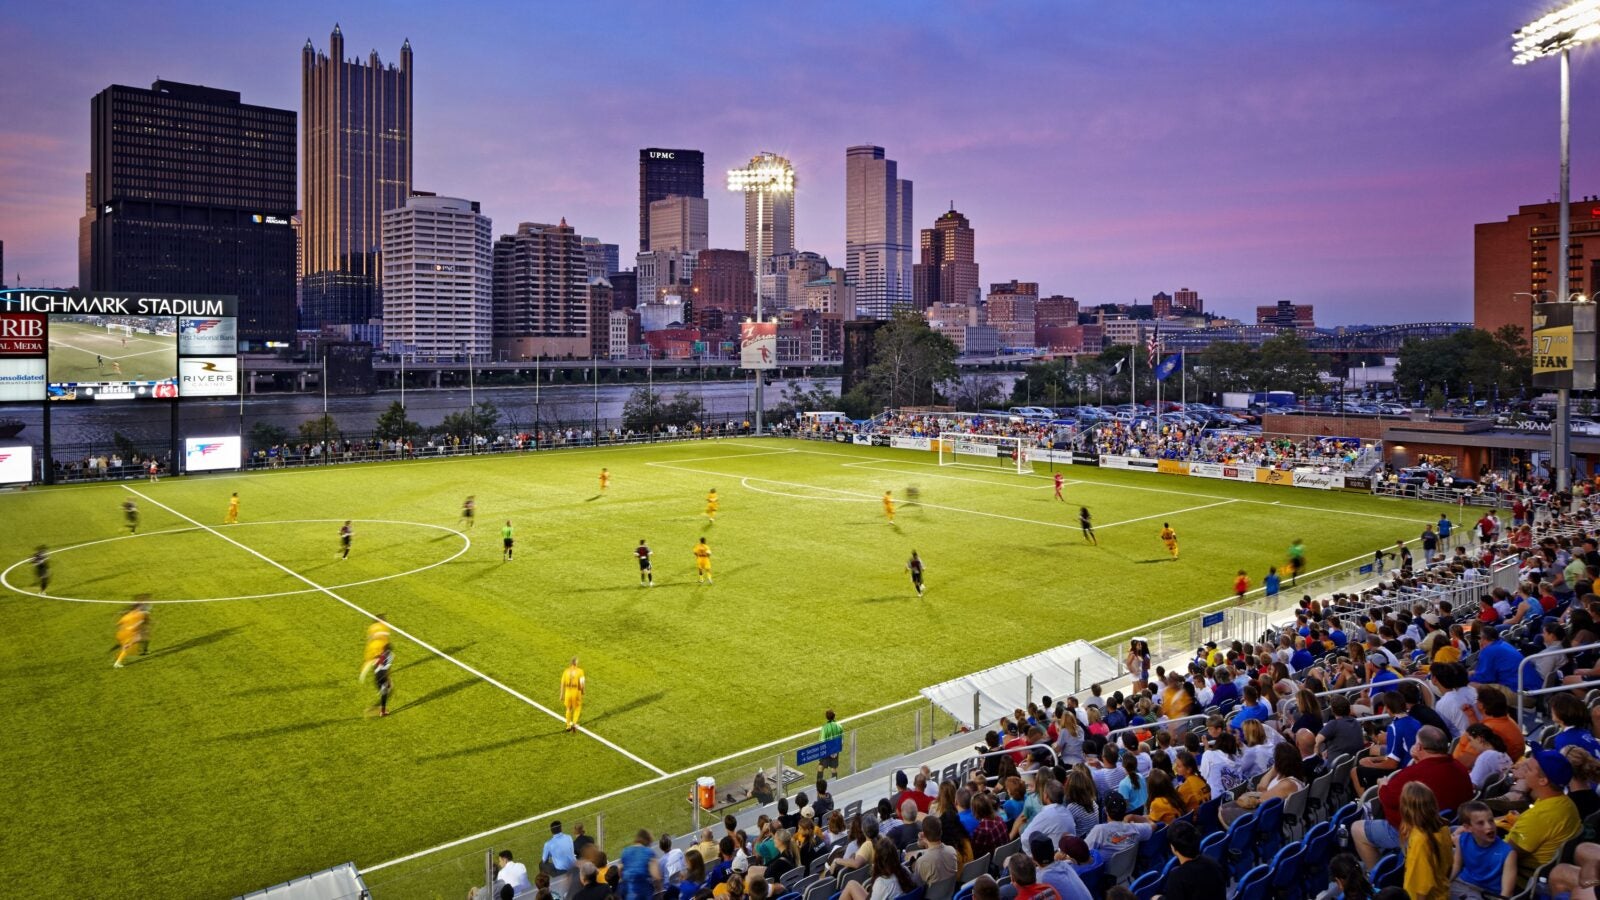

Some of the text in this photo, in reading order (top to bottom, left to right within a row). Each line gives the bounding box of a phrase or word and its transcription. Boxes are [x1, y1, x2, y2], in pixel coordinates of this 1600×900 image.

[649, 151, 675, 159] UPMC
[6, 291, 224, 316] HIGHMARK STADIUM
[0, 318, 43, 337] RIB
[13, 341, 43, 350] MEDIA
[1541, 356, 1568, 368] FAN
[1295, 474, 1330, 486] Yuengling
